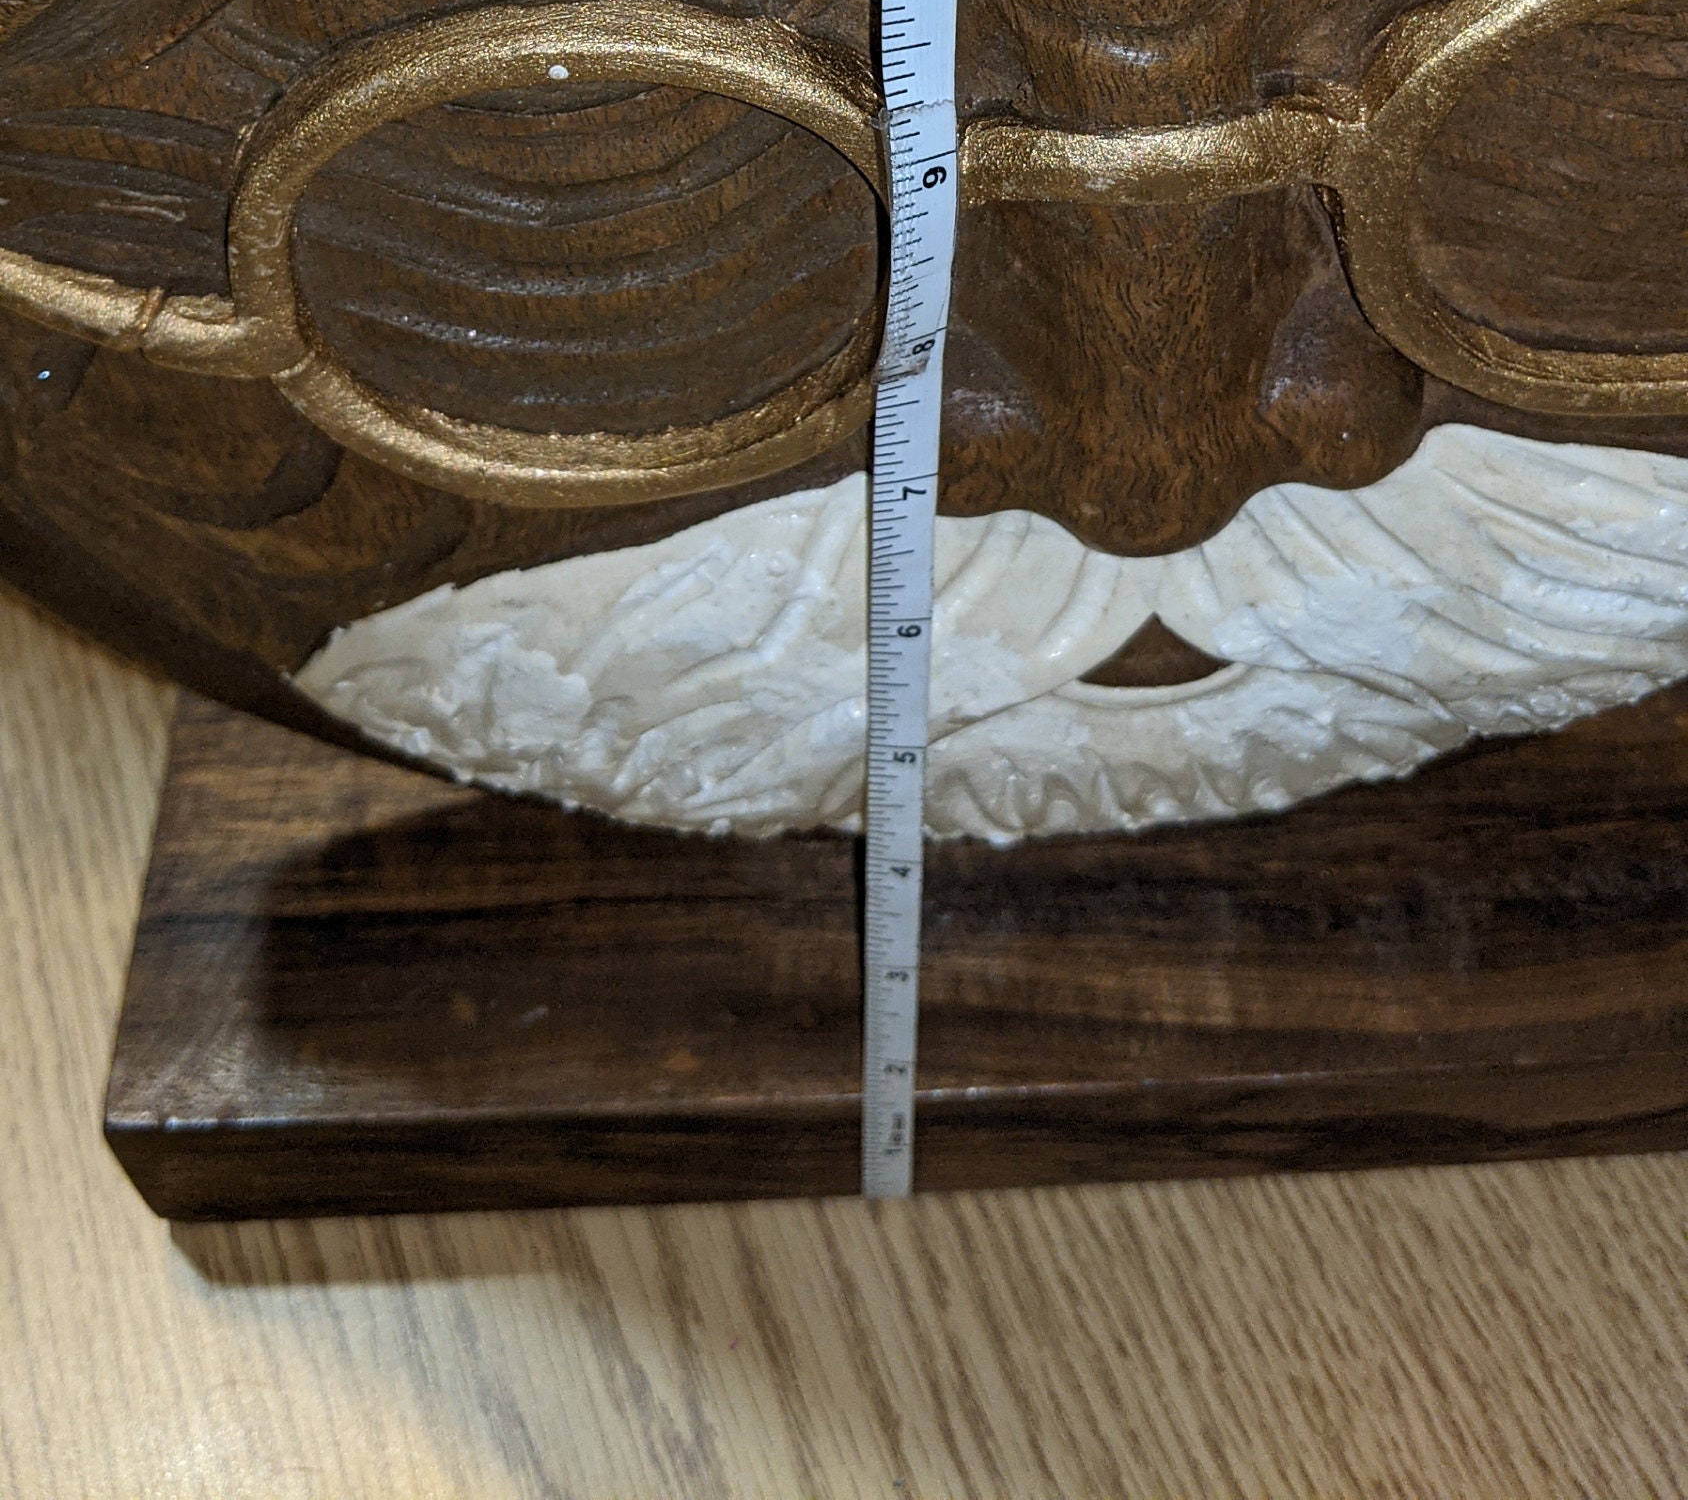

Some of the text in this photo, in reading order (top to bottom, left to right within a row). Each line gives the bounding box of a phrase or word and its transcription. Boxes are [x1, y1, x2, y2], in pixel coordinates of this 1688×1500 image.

[922, 165, 947, 190] 9
[911, 338, 936, 356] 8
[902, 485, 928, 501] 7
[896, 623, 922, 639] 6
[892, 751, 917, 764] 5
[889, 865, 912, 879] 4
